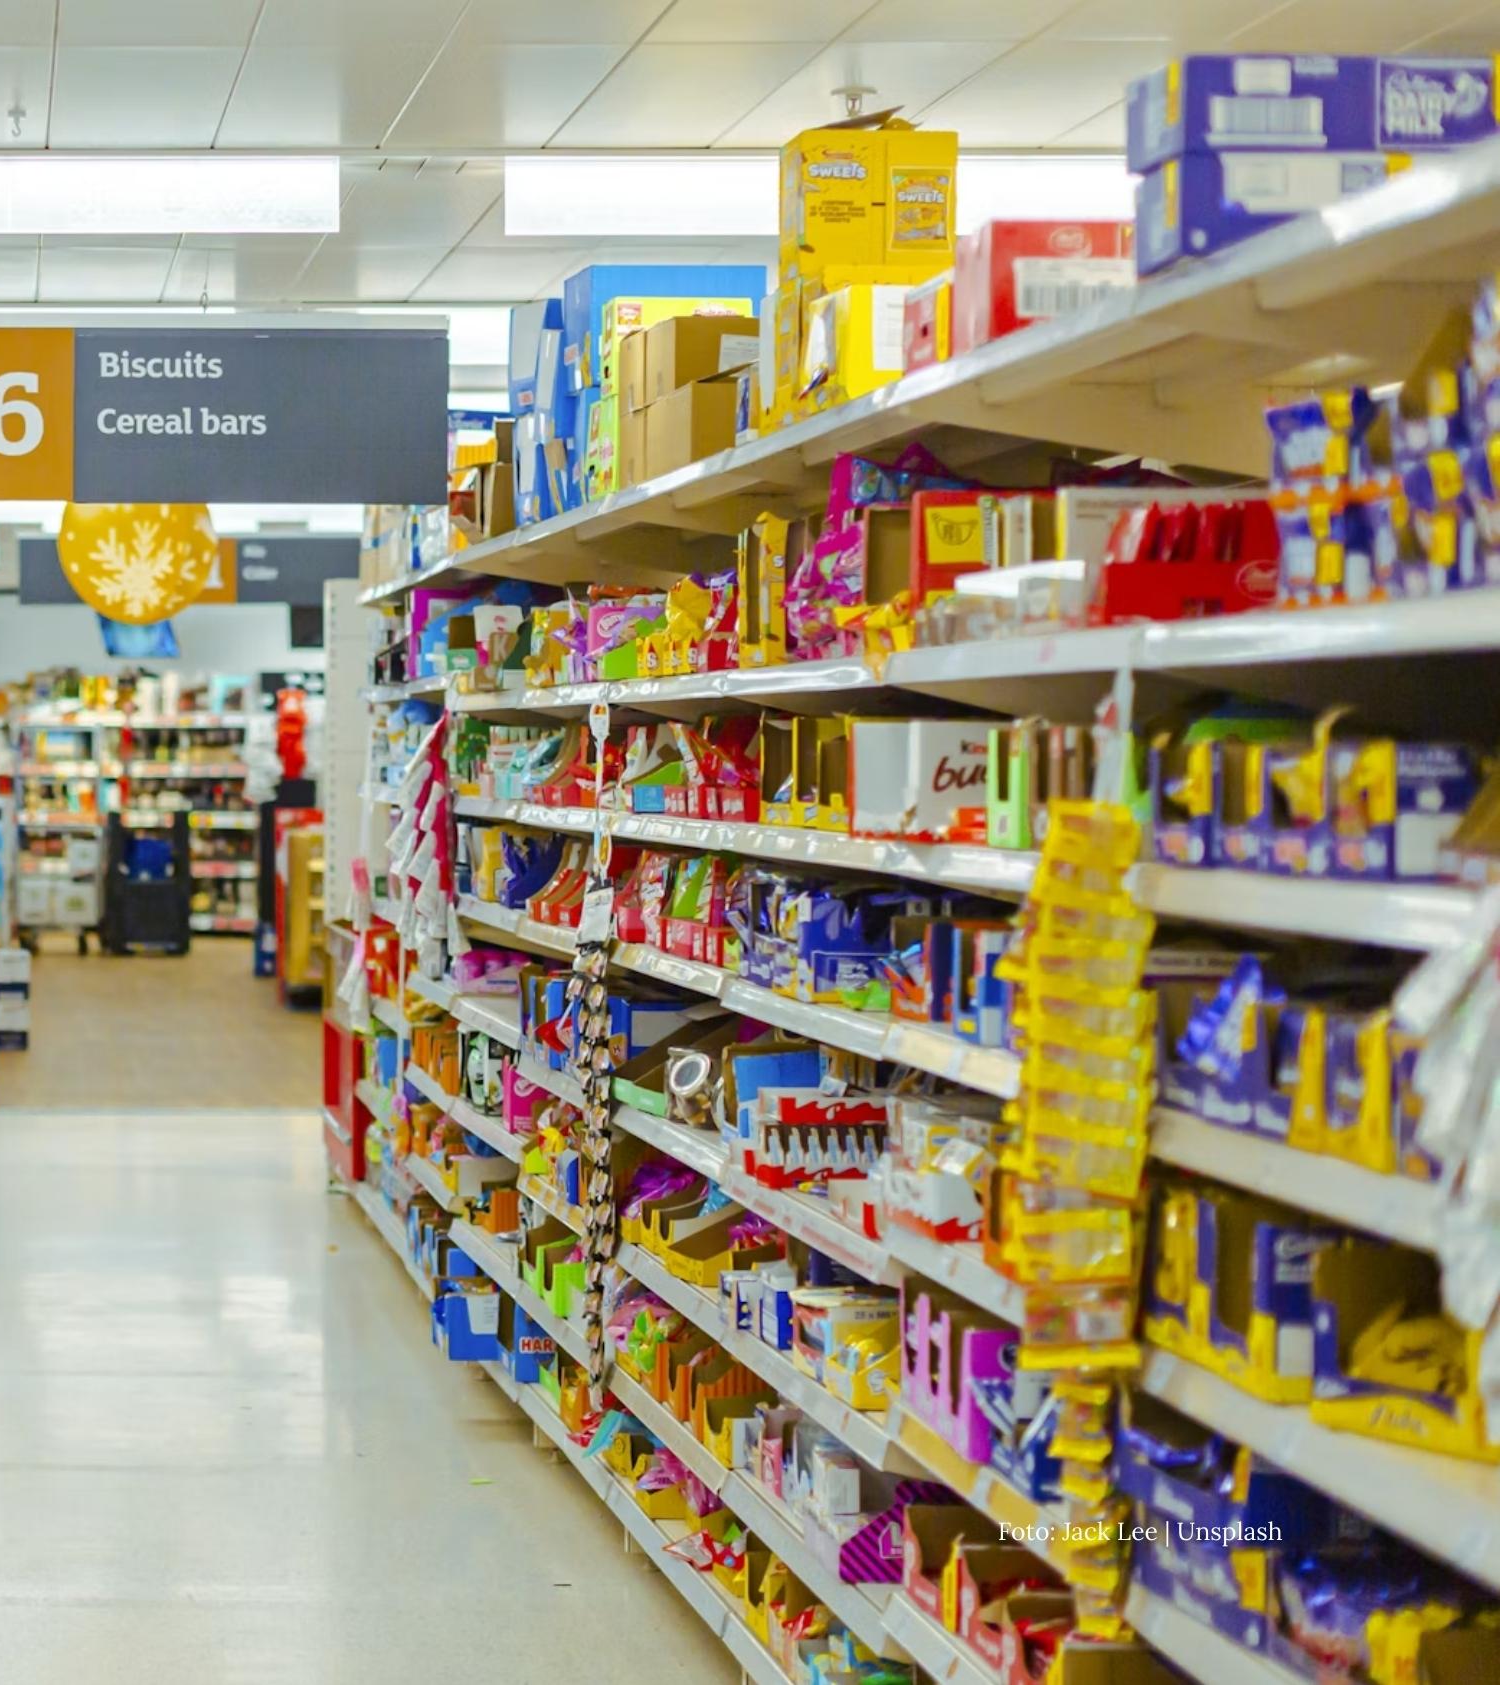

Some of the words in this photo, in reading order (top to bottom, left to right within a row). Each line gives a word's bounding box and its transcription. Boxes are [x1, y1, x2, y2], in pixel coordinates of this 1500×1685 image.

[808, 162, 867, 180] SWEETS
[897, 190, 945, 203] SWEETS
[99, 351, 223, 378] Biscuits
[97, 407, 192, 435] Cereal
[201, 407, 267, 435] bars
[519, 1336, 556, 1354] HAR
